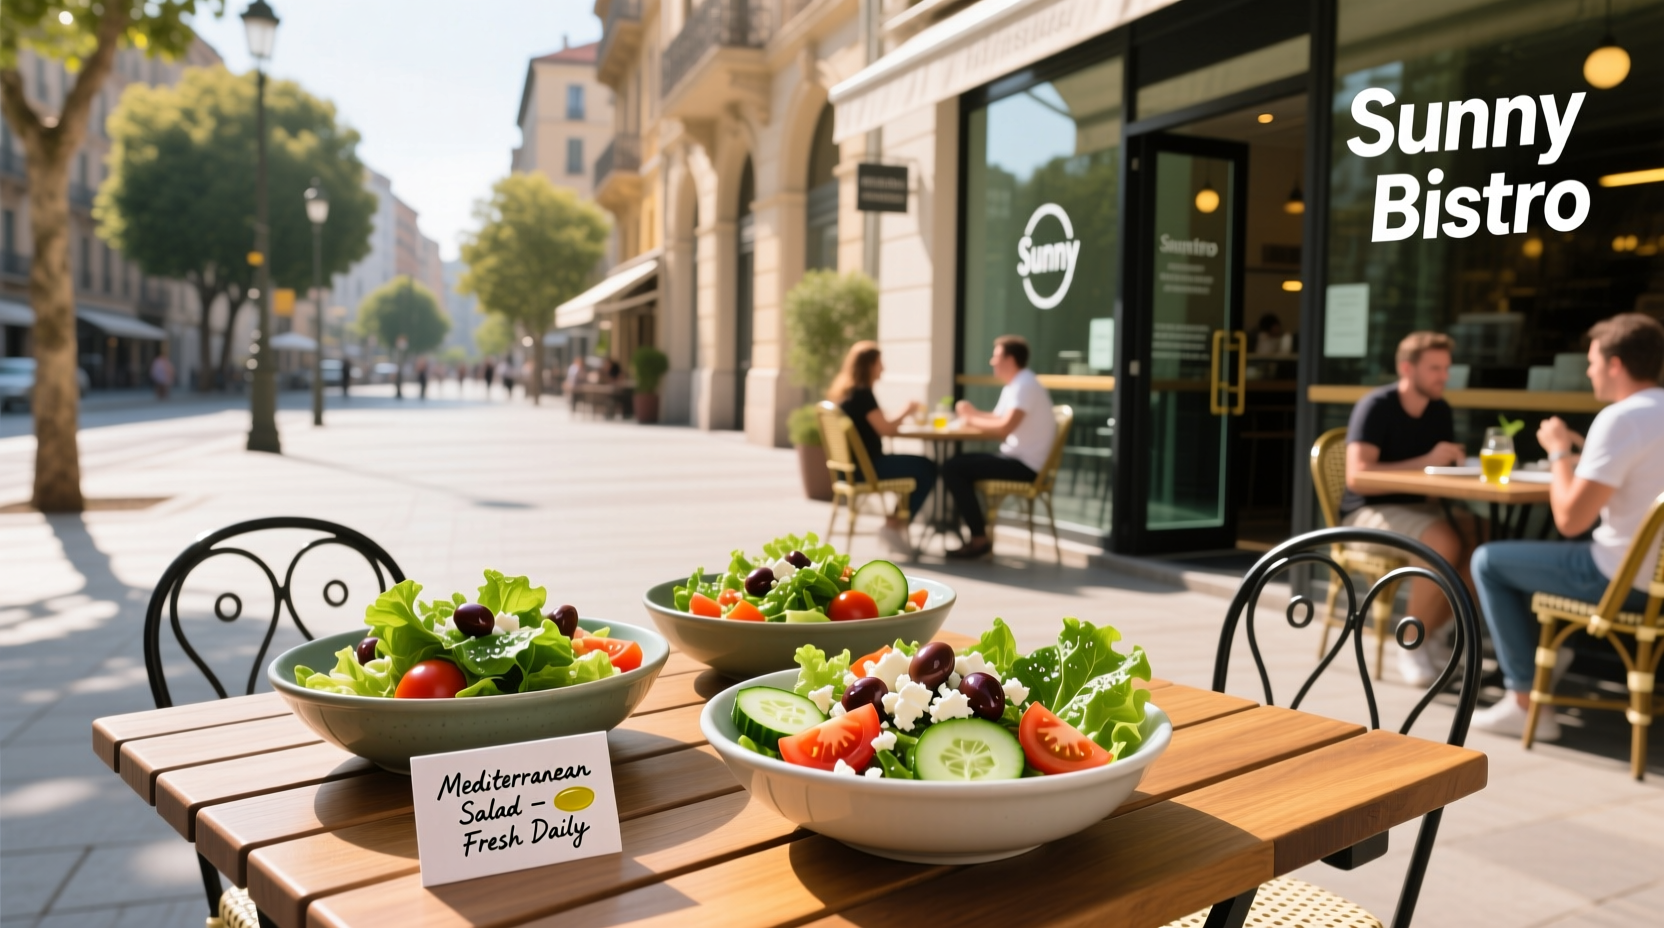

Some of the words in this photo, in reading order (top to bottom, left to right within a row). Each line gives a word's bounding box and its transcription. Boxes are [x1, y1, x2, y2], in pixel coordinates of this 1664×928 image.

[1346, 87, 1587, 165] Sunny
[1371, 168, 1591, 243] Bistro
[1017, 236, 1081, 285] Sunny
[437, 764, 591, 801] Mediterranean
[459, 795, 522, 825] Salad
[463, 825, 523, 857] Fresh
[531, 815, 590, 848] Daily
